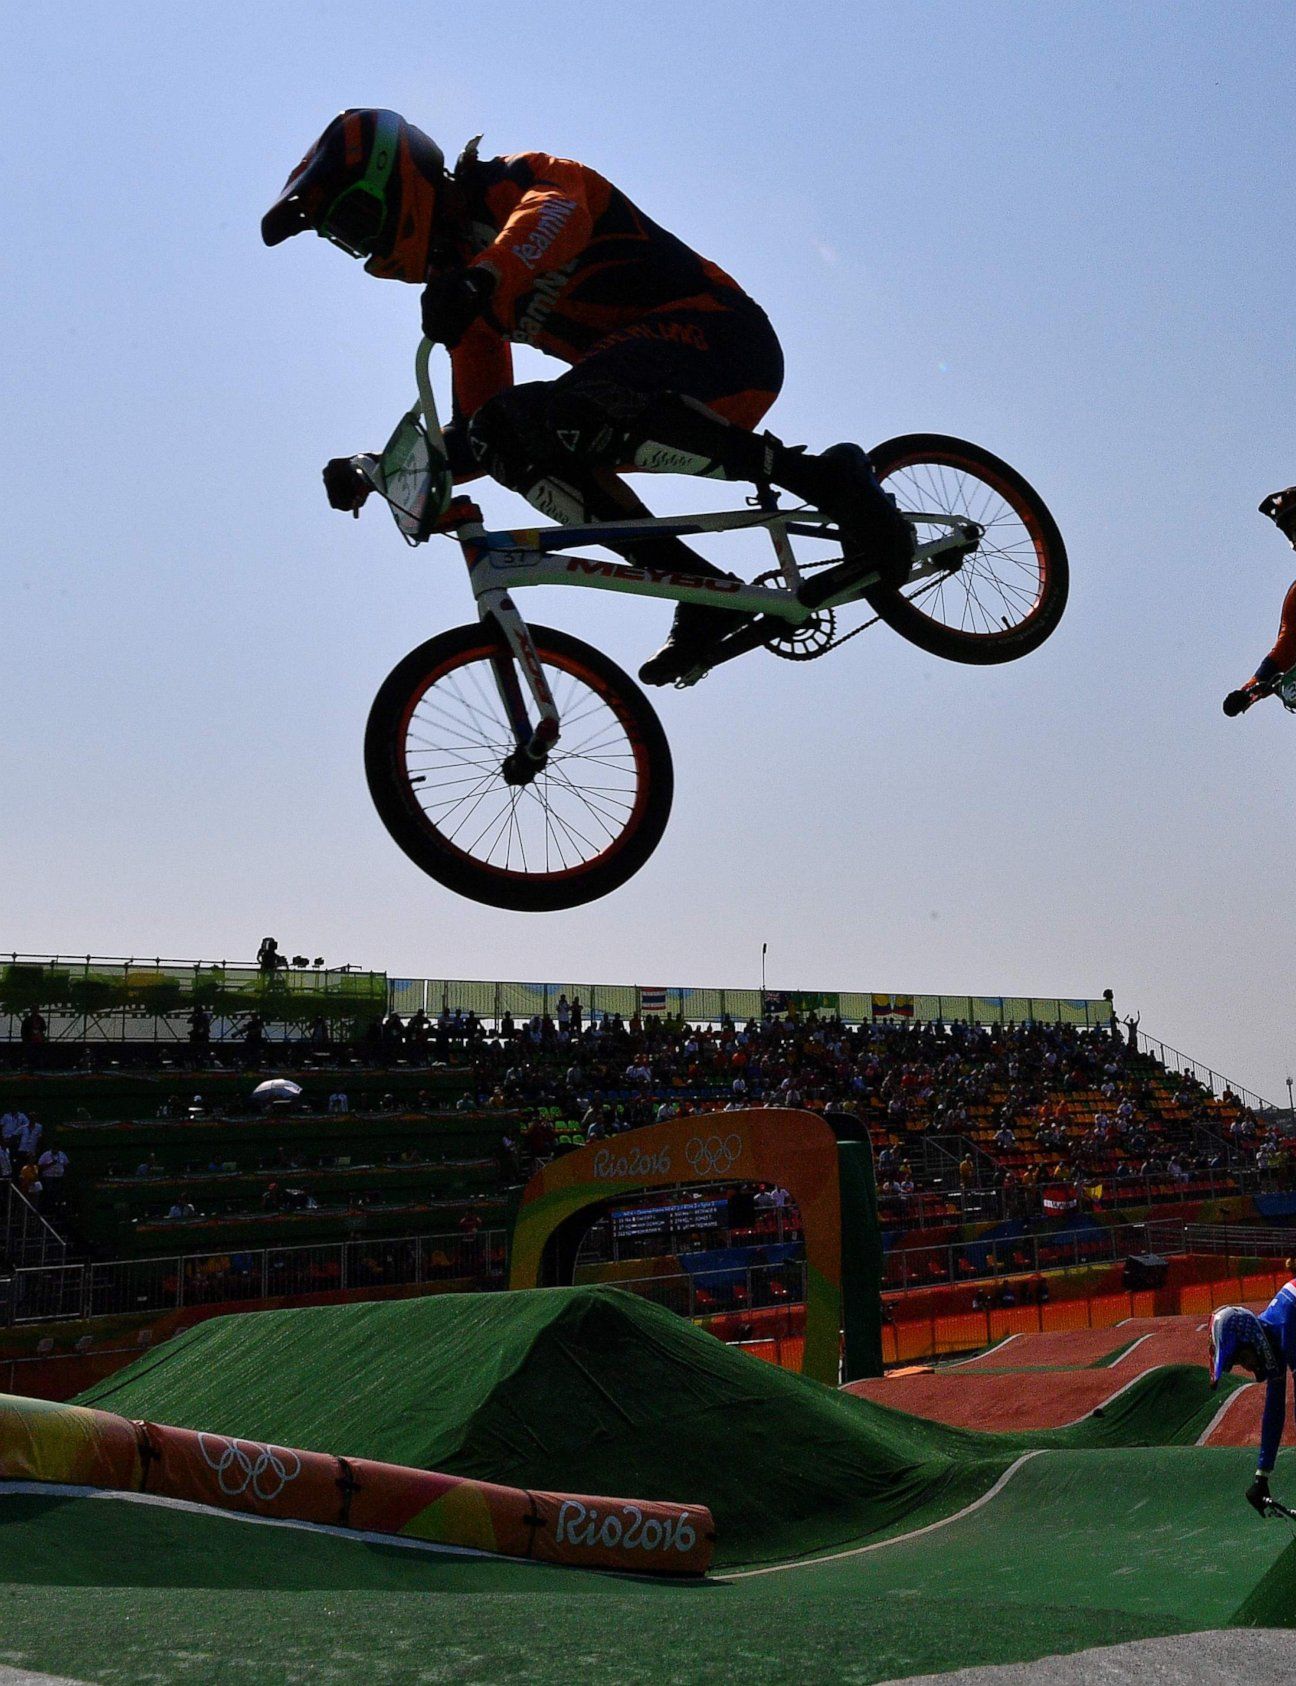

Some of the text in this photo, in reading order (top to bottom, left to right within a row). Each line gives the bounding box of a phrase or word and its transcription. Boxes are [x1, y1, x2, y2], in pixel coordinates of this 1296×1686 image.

[566, 557, 741, 593] MEYBO
[592, 1146, 672, 1178] Rio2016
[555, 1500, 696, 1552] Rio2016
